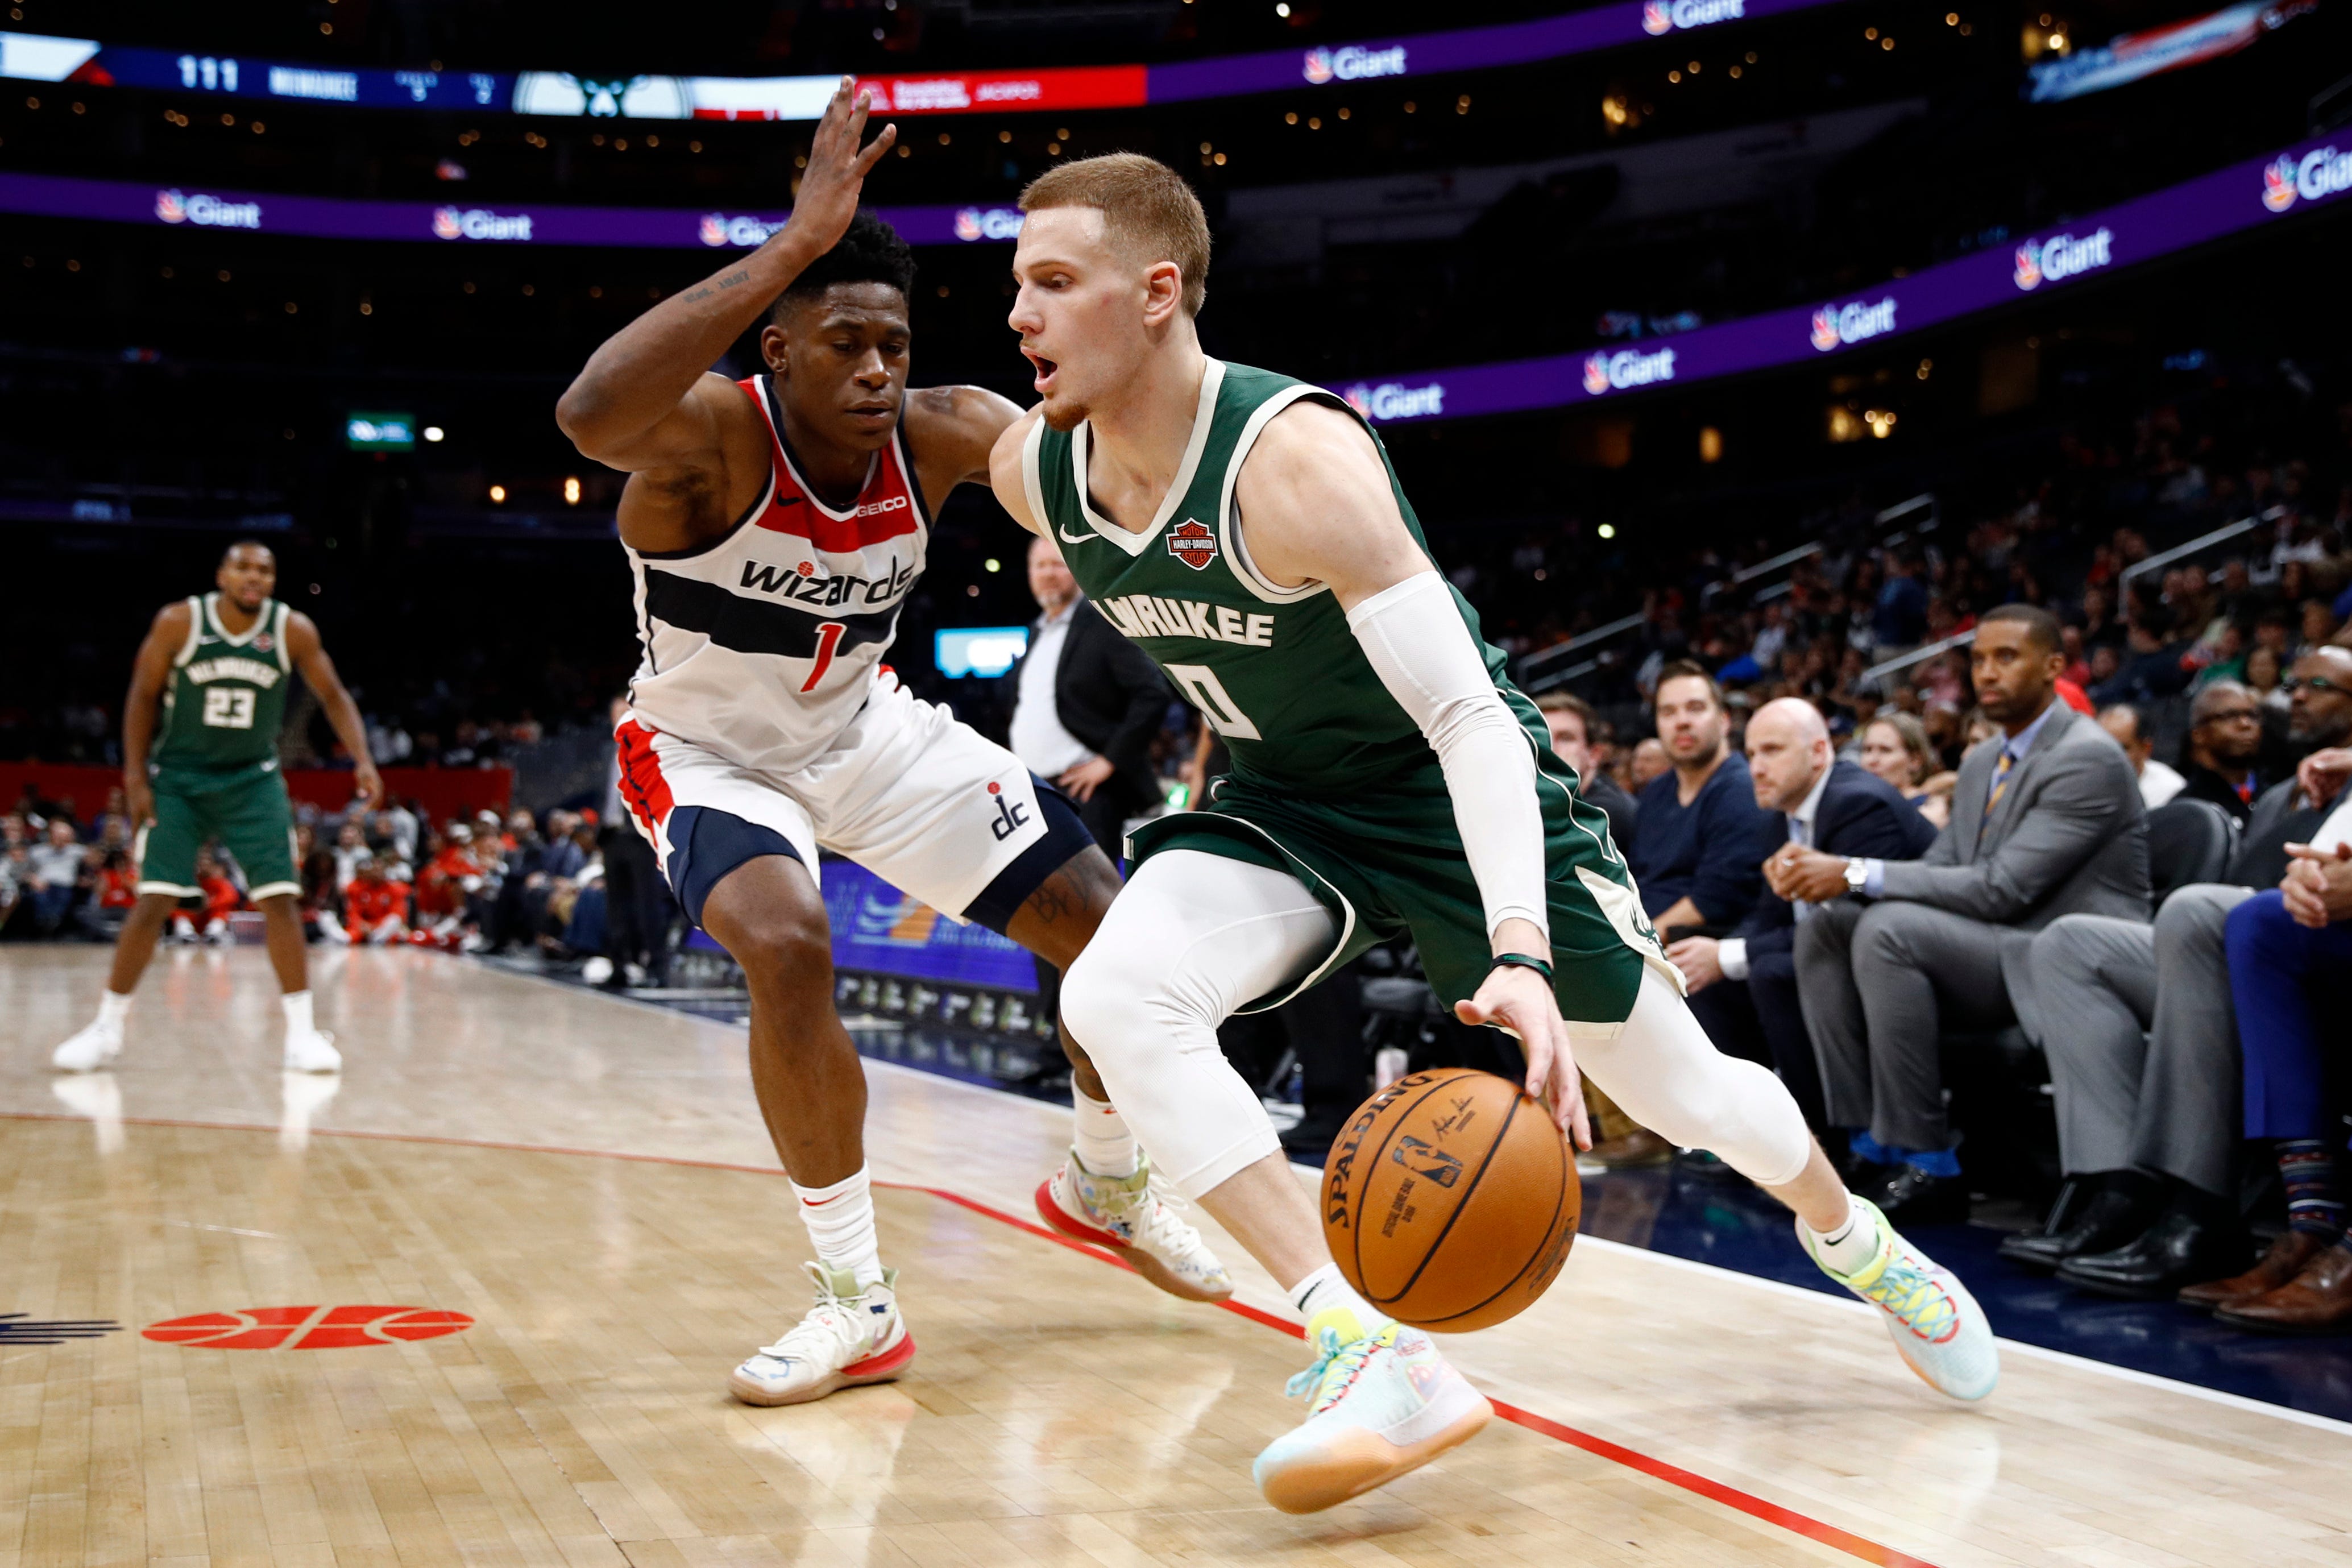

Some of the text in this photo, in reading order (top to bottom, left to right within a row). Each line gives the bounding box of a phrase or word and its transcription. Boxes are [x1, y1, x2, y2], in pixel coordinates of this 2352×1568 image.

[179, 55, 238, 92] 111
[1333, 44, 1408, 81] Giant
[2297, 145, 2352, 200] Gia
[186, 194, 262, 229] Giant
[461, 209, 532, 241] Giant
[2041, 226, 2114, 281] Giant
[1839, 295, 1898, 343] Giant
[1609, 346, 1677, 389] Giant
[1371, 382, 1445, 420] Giant
[857, 496, 907, 518] GEICO
[1172, 539, 1214, 549] HARLEY-DAVIDSON
[1181, 526, 1205, 536] MOTOR
[740, 554, 915, 607] wizards
[799, 624, 844, 692] 1
[202, 686, 256, 729] 23
[1163, 663, 1263, 741] 0
[1328, 1075, 1435, 1229] SPALDING
